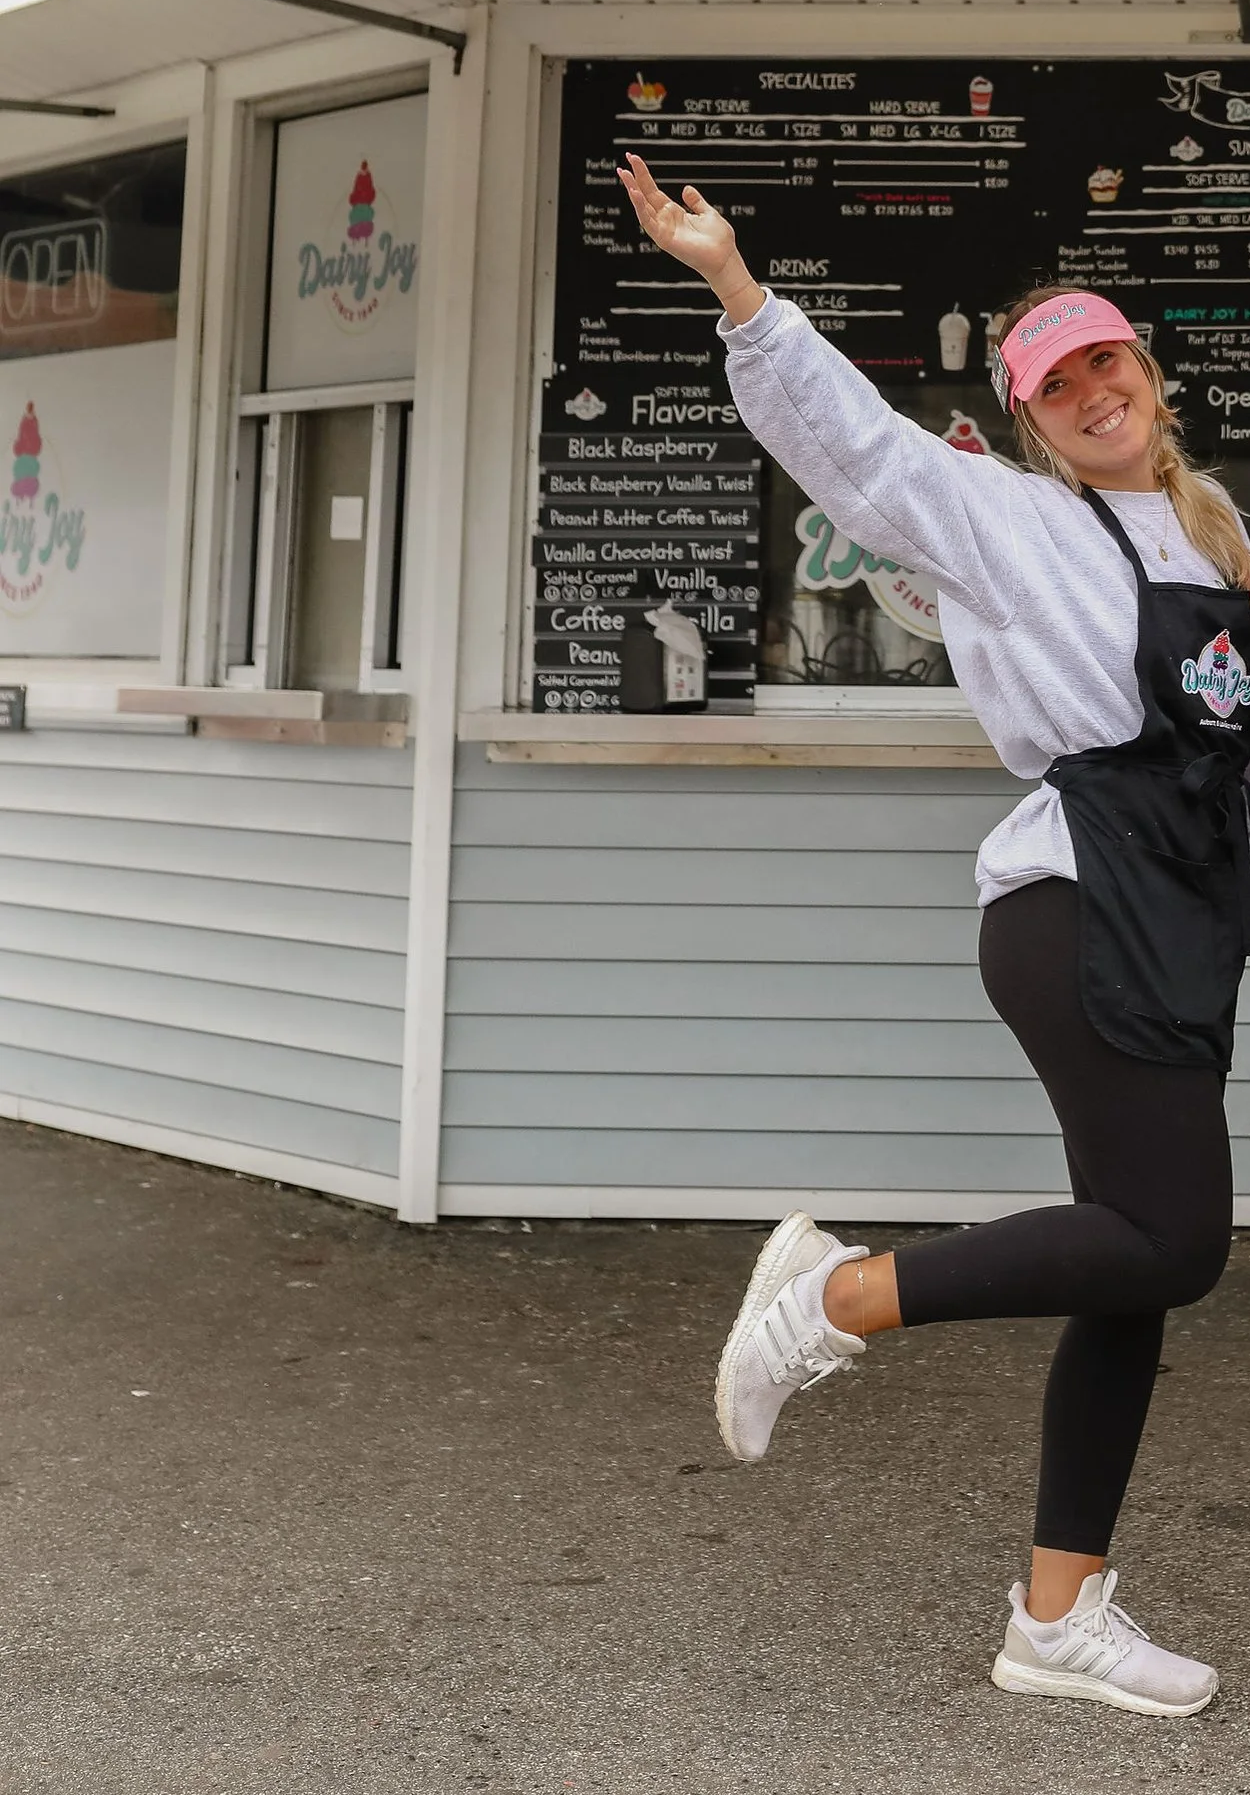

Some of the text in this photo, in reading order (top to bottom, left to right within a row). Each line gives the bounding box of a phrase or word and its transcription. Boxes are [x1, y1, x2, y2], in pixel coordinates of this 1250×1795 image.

[759, 72, 857, 90] SPECIALTIES
[684, 99, 750, 113] SOFT SERVE
[869, 101, 941, 114] HARD SERVE
[642, 123, 697, 137] SM MED
[840, 124, 896, 138] SM MED
[1186, 173, 1250, 186] SOFT SERVE
[1172, 215, 1191, 225] KID
[1219, 214, 1240, 225] MED
[5, 232, 103, 322] OPEN
[298, 231, 418, 303] Dairy Joy
[769, 259, 830, 277] DRINKS
[1164, 308, 1208, 321] DAIRY
[1211, 308, 1238, 321] JOY
[1018, 303, 1087, 347] Dairy Joy
[632, 393, 738, 425] Flavors
[568, 436, 718, 463] Black Raspberry
[550, 475, 754, 497] Black Raspberry Vanilla Twist
[550, 508, 750, 526] Peanut Butter Coffee Twist
[544, 541, 734, 563] Vanilla Chocolate Twist
[544, 568, 638, 586] Salted Caramel
[654, 567, 719, 590] Vanilla
[893, 580, 938, 619] SINC
[551, 606, 626, 631] Coffee
[1182, 661, 1228, 702] Dairy
